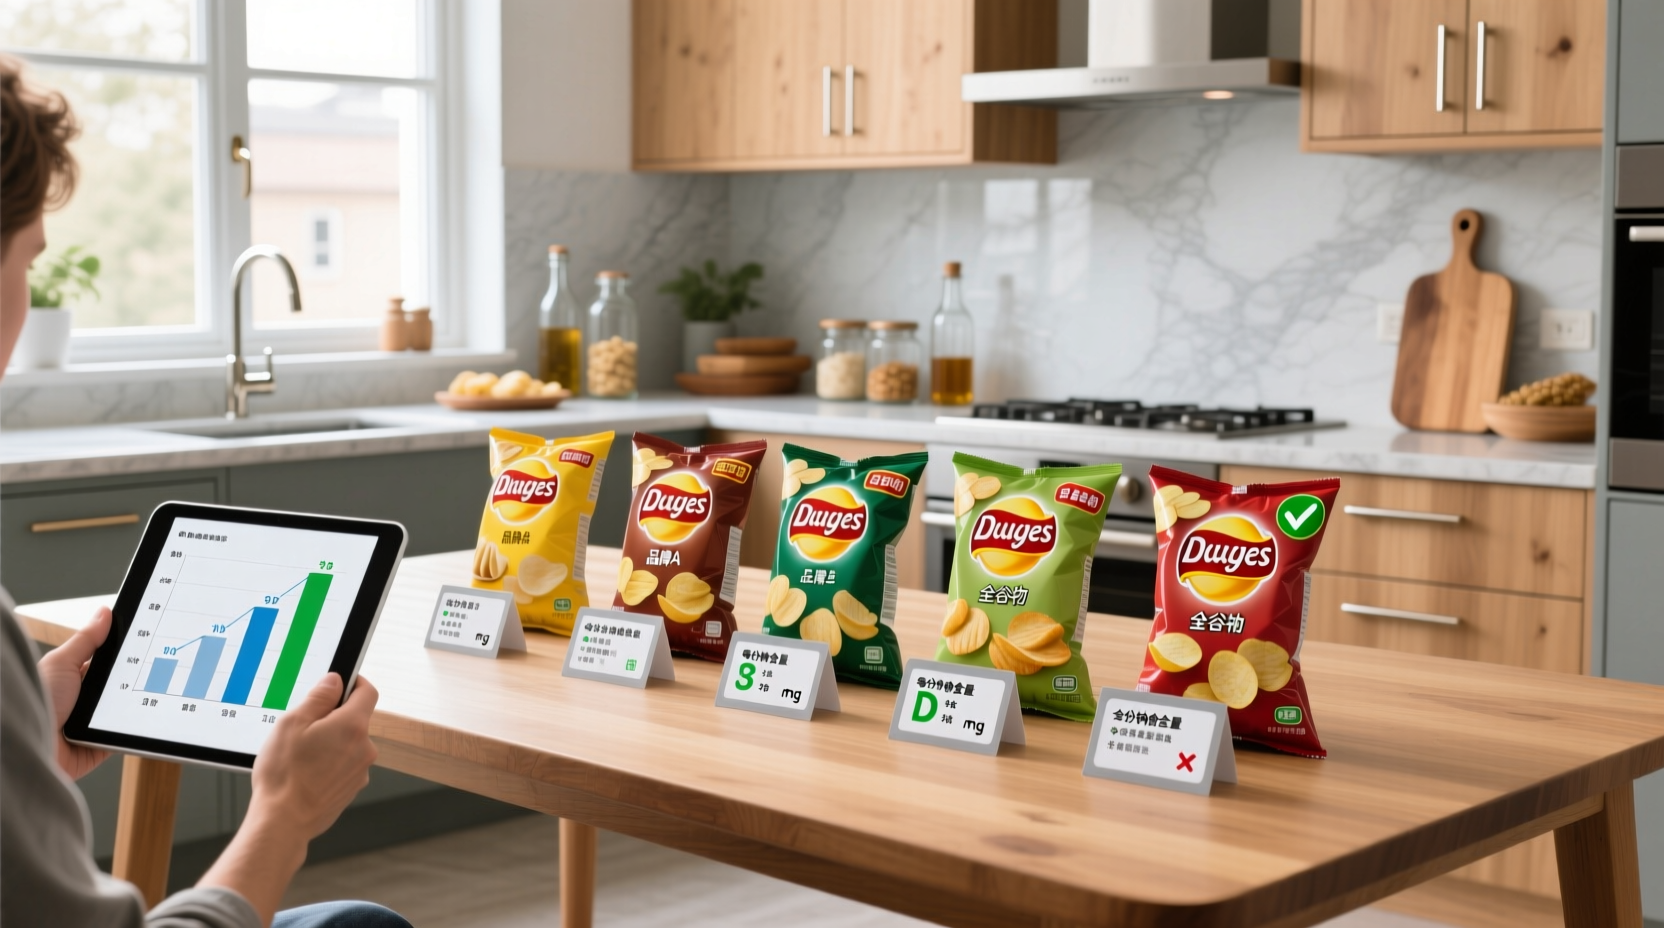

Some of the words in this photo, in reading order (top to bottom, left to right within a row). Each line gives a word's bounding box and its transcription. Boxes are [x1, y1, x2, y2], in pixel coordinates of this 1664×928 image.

[781, 688, 802, 704] mg
[911, 690, 938, 722] D
[963, 719, 985, 736] mg
